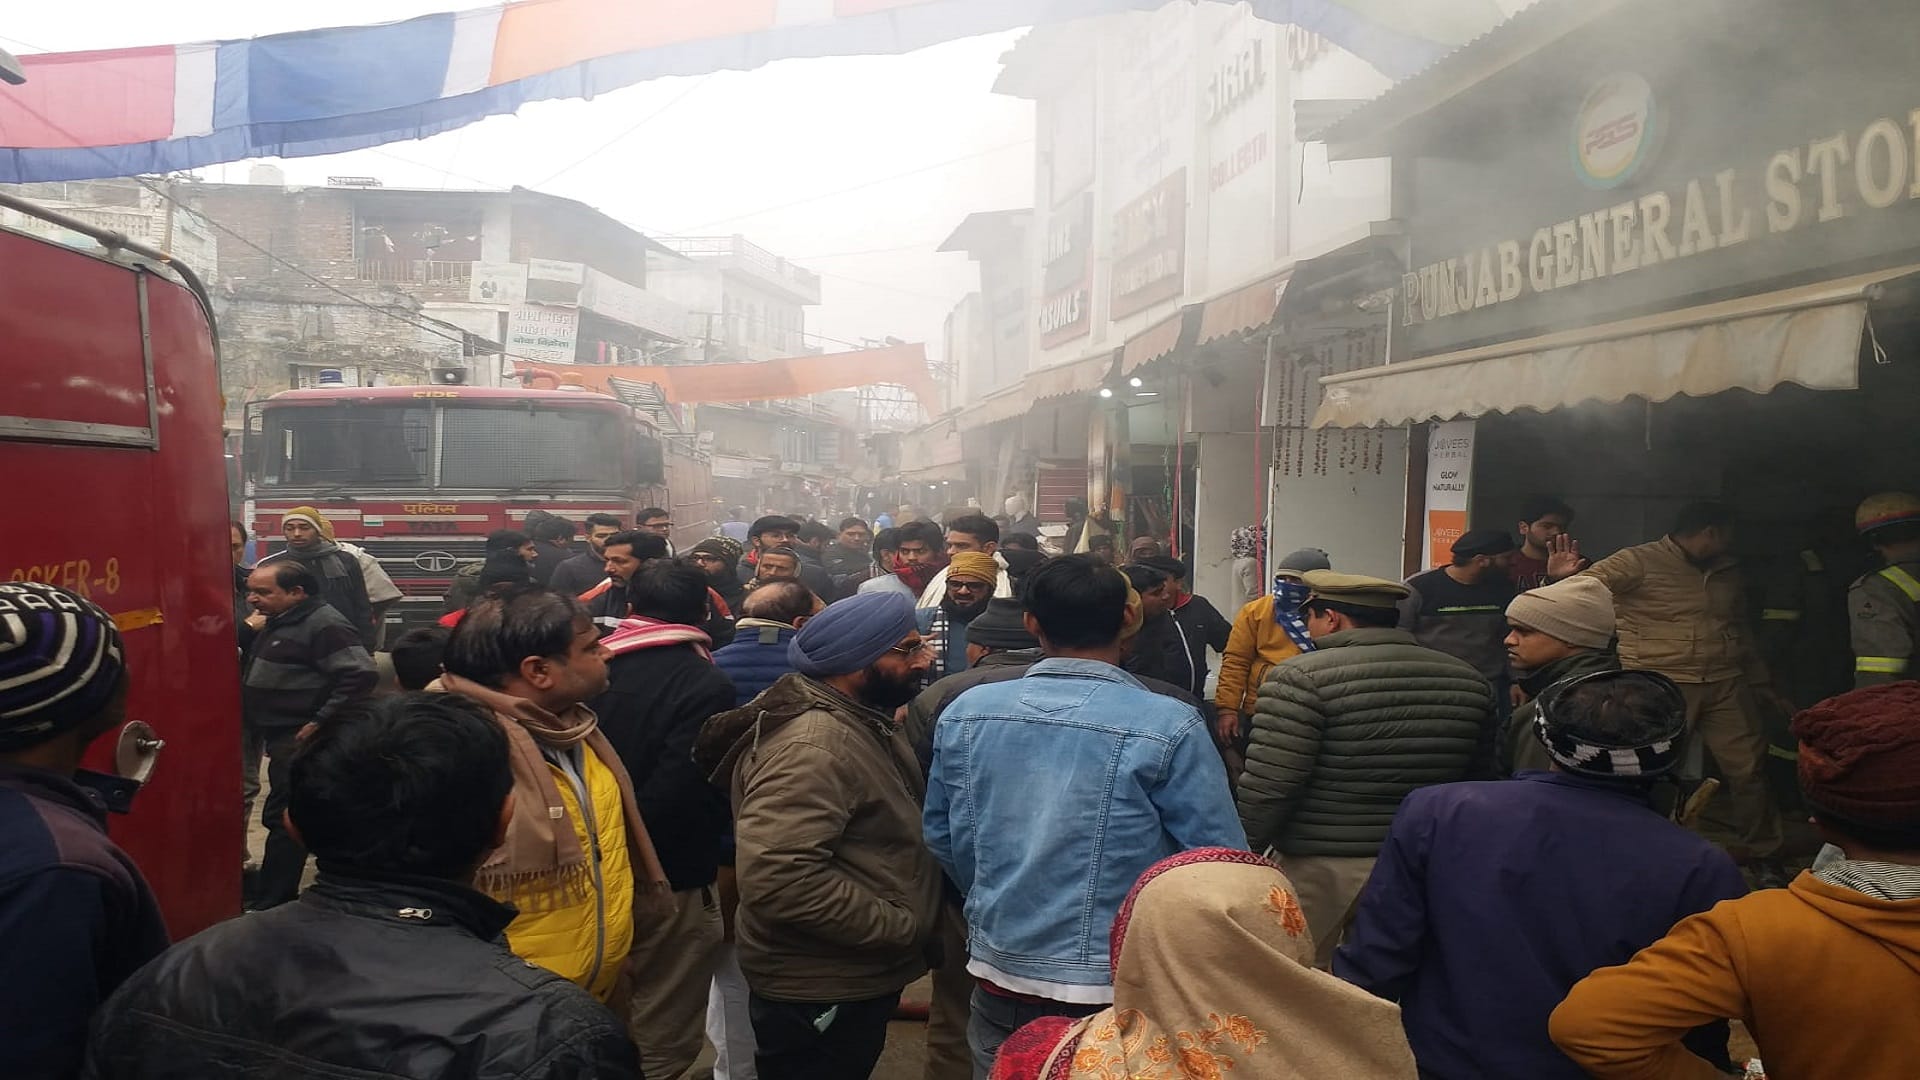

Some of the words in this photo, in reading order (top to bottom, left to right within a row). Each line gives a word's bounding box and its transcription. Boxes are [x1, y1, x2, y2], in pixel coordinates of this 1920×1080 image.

[1402, 240, 1522, 326] PUNJAB
[1529, 168, 1750, 292] GENERAL
[1432, 484, 1466, 492] NATURALLY
[403, 502, 460, 515] पुलिस
